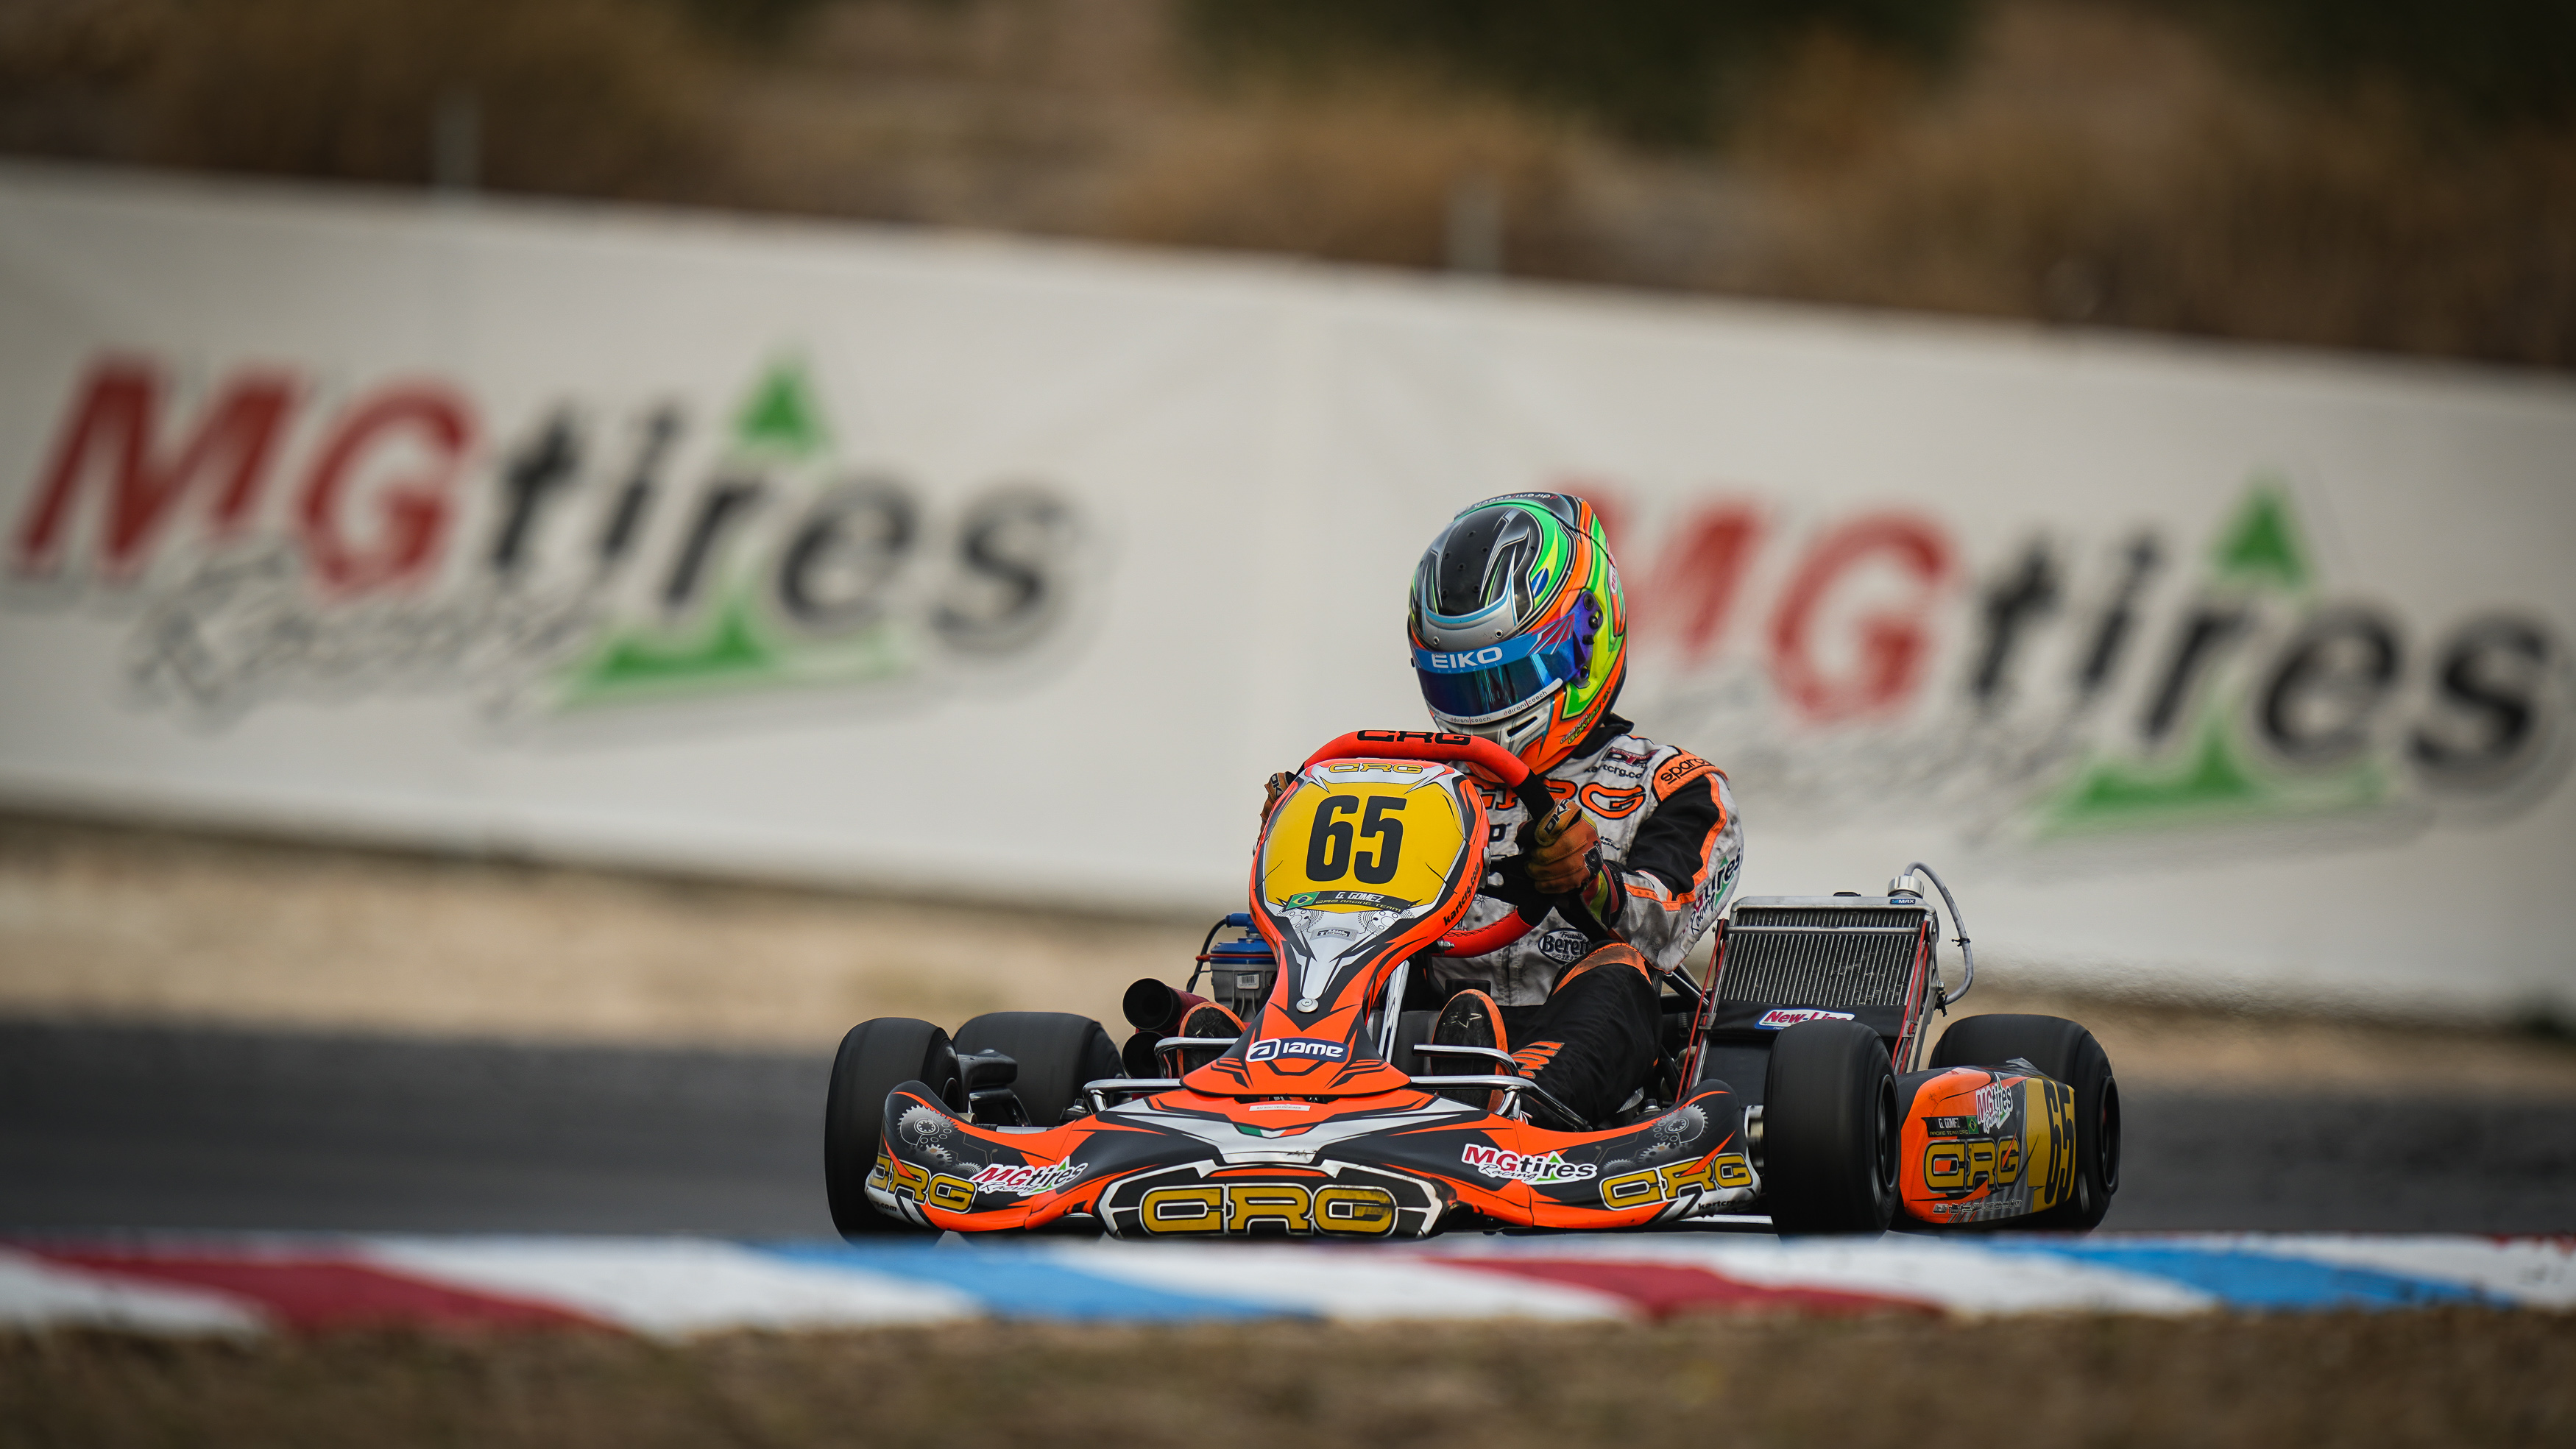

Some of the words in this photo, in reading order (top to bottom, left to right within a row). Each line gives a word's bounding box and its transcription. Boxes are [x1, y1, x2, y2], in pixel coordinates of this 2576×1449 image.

[11, 352, 1071, 653] MGtires
[1432, 647, 1503, 668] EIKO
[1356, 730, 1471, 746] CRG
[1328, 763, 1423, 774] CRG
[1584, 764, 1644, 779] kartcrg.co
[1306, 795, 1407, 885] 65
[1335, 891, 1345, 899] G.
[1347, 892, 1384, 903] GOMEZ
[1375, 903, 1401, 913] TEAM
[1443, 862, 1479, 927] kartcrg.com
[1690, 892, 1716, 935] Racing
[1543, 935, 1590, 955] Berett
[1977, 1083, 2012, 1122] MGtires
[972, 1162, 1086, 1187] MGtires
[1464, 1146, 1595, 1178] MGtires
[1480, 1163, 1538, 1182] Racing
[1924, 1137, 2021, 1194] CRG
[867, 1154, 977, 1214] CRG
[1599, 1153, 1755, 1211] CRG
[1140, 1183, 1398, 1237] CRG
